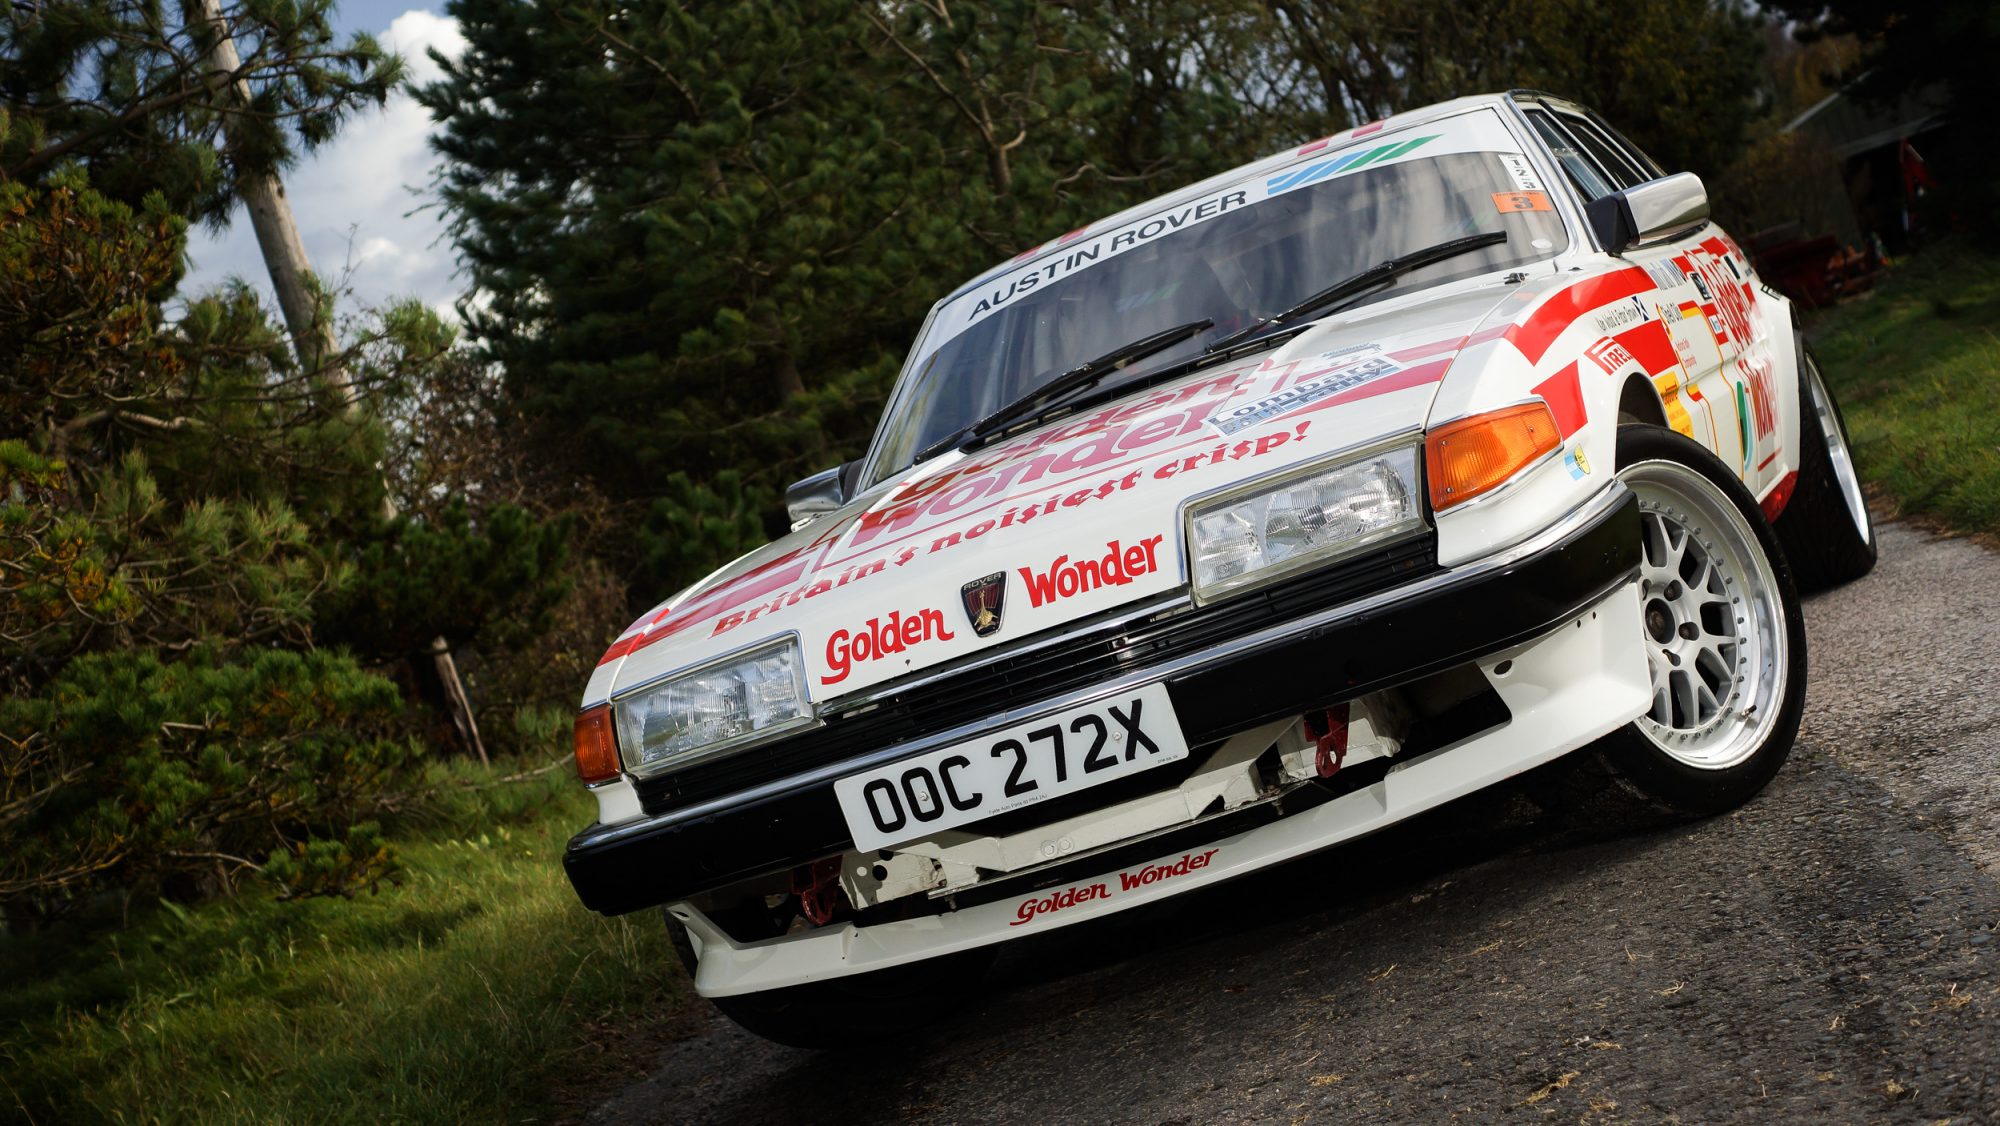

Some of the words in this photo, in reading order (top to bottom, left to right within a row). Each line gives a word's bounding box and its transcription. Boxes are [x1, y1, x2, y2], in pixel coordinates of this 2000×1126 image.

[968, 244, 1100, 322] AUSTIN
[1110, 190, 1247, 252] ROVER
[1511, 196, 1534, 209] 3
[1207, 357, 1394, 426] Lombard
[847, 378, 1255, 548] Wonder
[708, 545, 920, 639] Britain's
[927, 470, 1144, 555] noisiest
[1153, 420, 1312, 480] crisp!
[963, 571, 1003, 592] ROVER
[820, 607, 955, 686] Golden
[1017, 533, 1163, 609] Wonder
[863, 755, 983, 834] OOC
[990, 698, 1160, 798] 272X
[1009, 882, 1112, 927] Golden
[1119, 848, 1220, 892] Wonder
